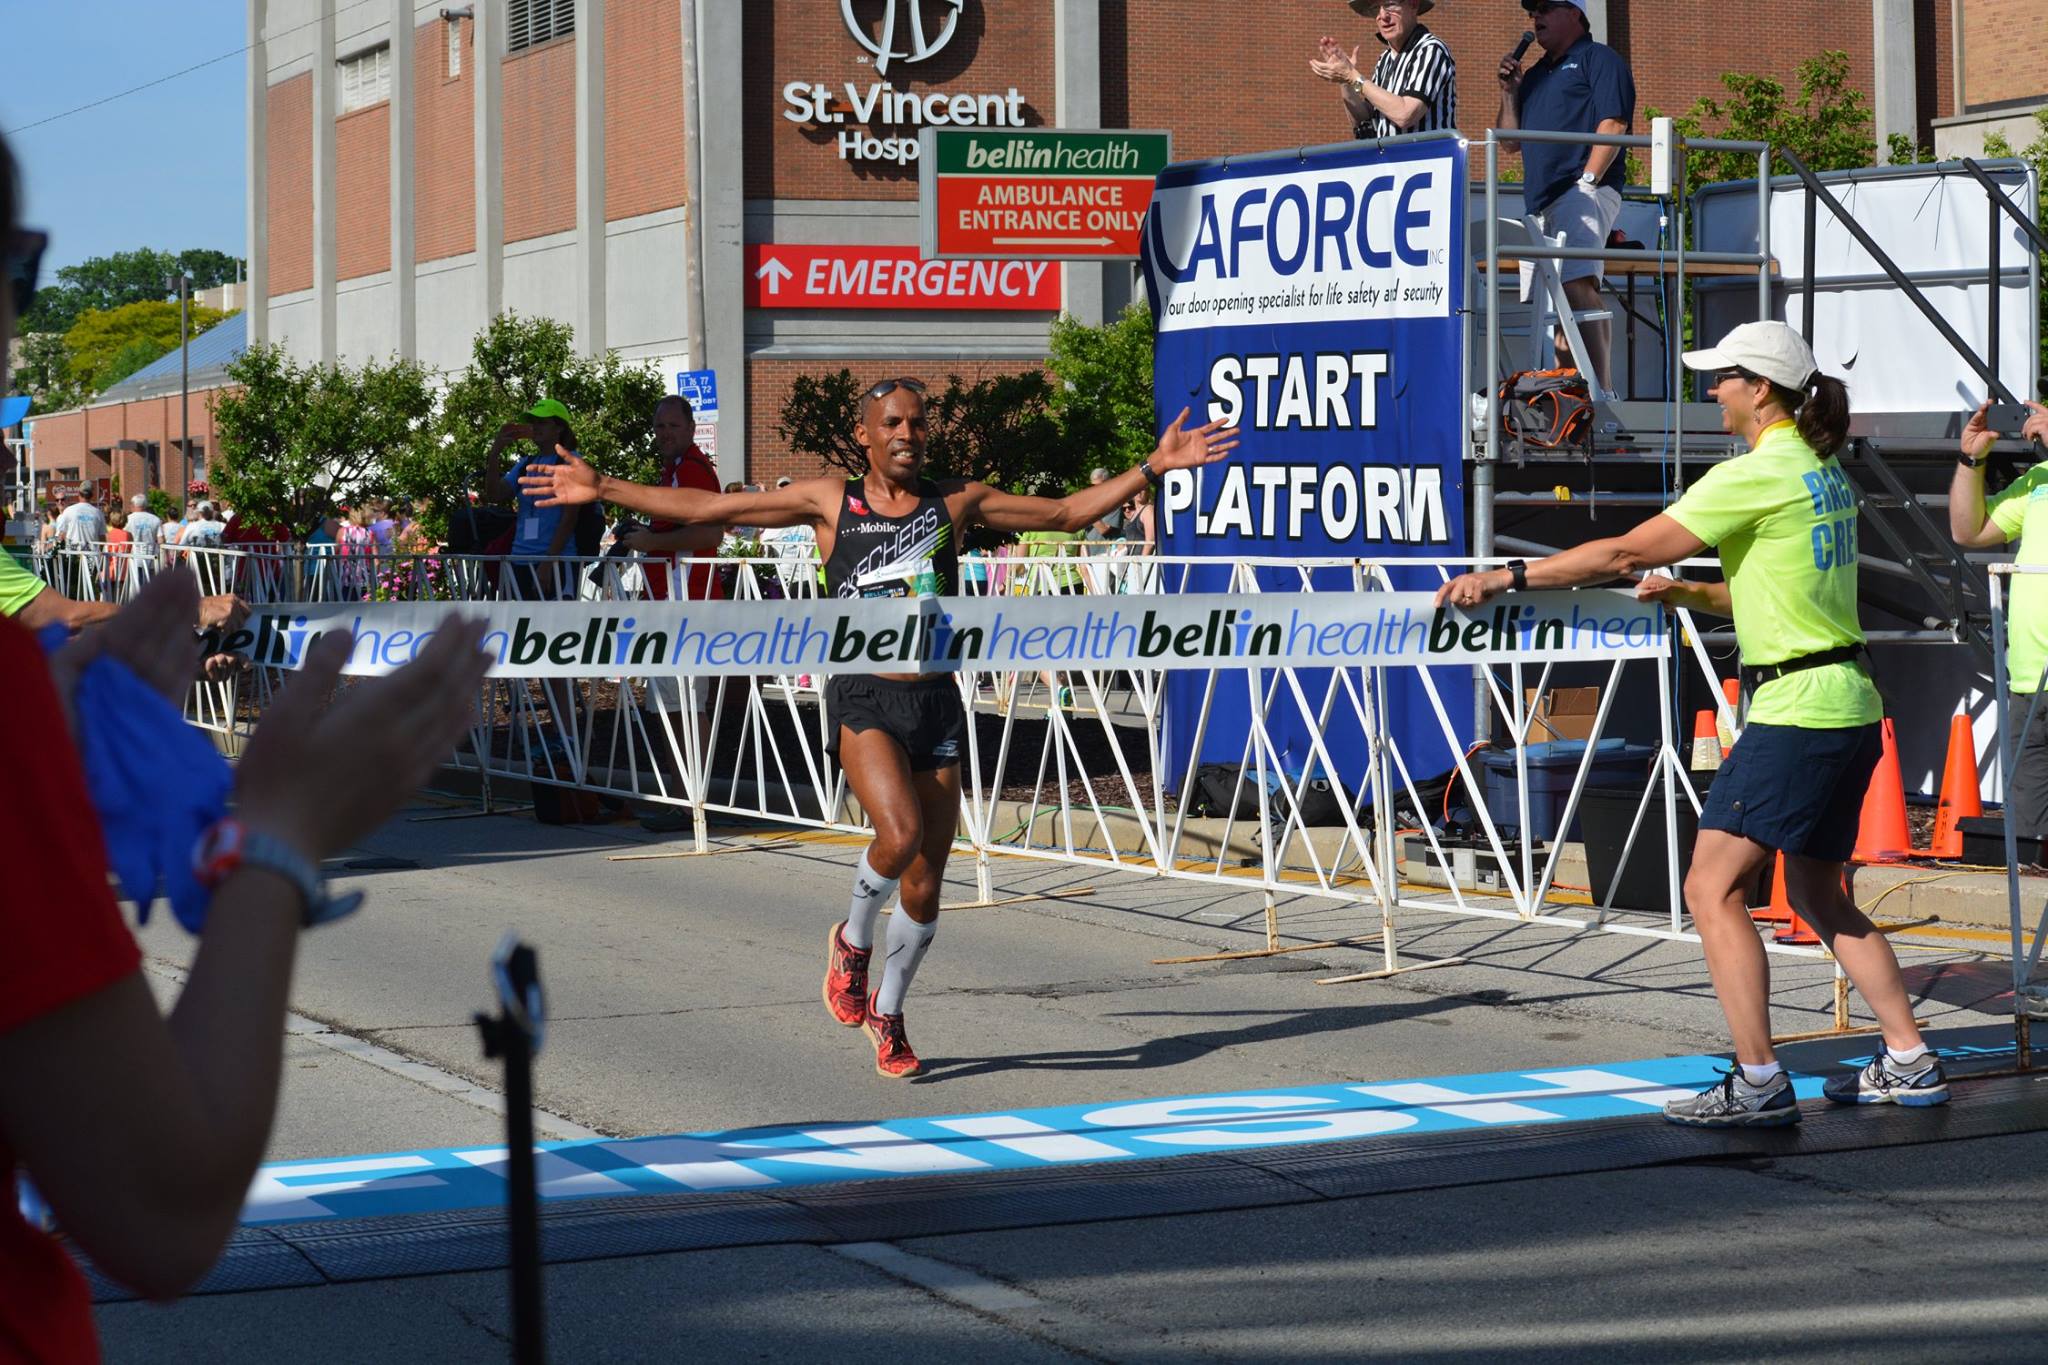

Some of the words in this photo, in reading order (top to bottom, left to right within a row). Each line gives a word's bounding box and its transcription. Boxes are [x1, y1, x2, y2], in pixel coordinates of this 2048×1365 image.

[838, 131, 920, 165] Hosp
[977, 185, 1123, 207] AMBULANCE
[958, 209, 1082, 231] ENTRANCE
[1086, 210, 1148, 231] ONLY
[1150, 171, 1434, 284] LAFORCE
[805, 259, 1049, 297] EMERGENCY
[1187, 292, 1211, 313] door
[1211, 291, 1254, 316] opening
[1258, 284, 1305, 316] specialist
[1308, 284, 1323, 307] for
[1325, 282, 1342, 306] life
[1347, 281, 1380, 308] safety
[1404, 281, 1444, 306] security
[699, 376, 710, 385] 77
[701, 386, 712, 394] 72
[1207, 353, 1388, 431] START
[1164, 466, 1449, 543] PLATFORM
[1802, 466, 1856, 516] RAC
[860, 522, 897, 534] Mobile
[1811, 517, 1858, 572] CRE
